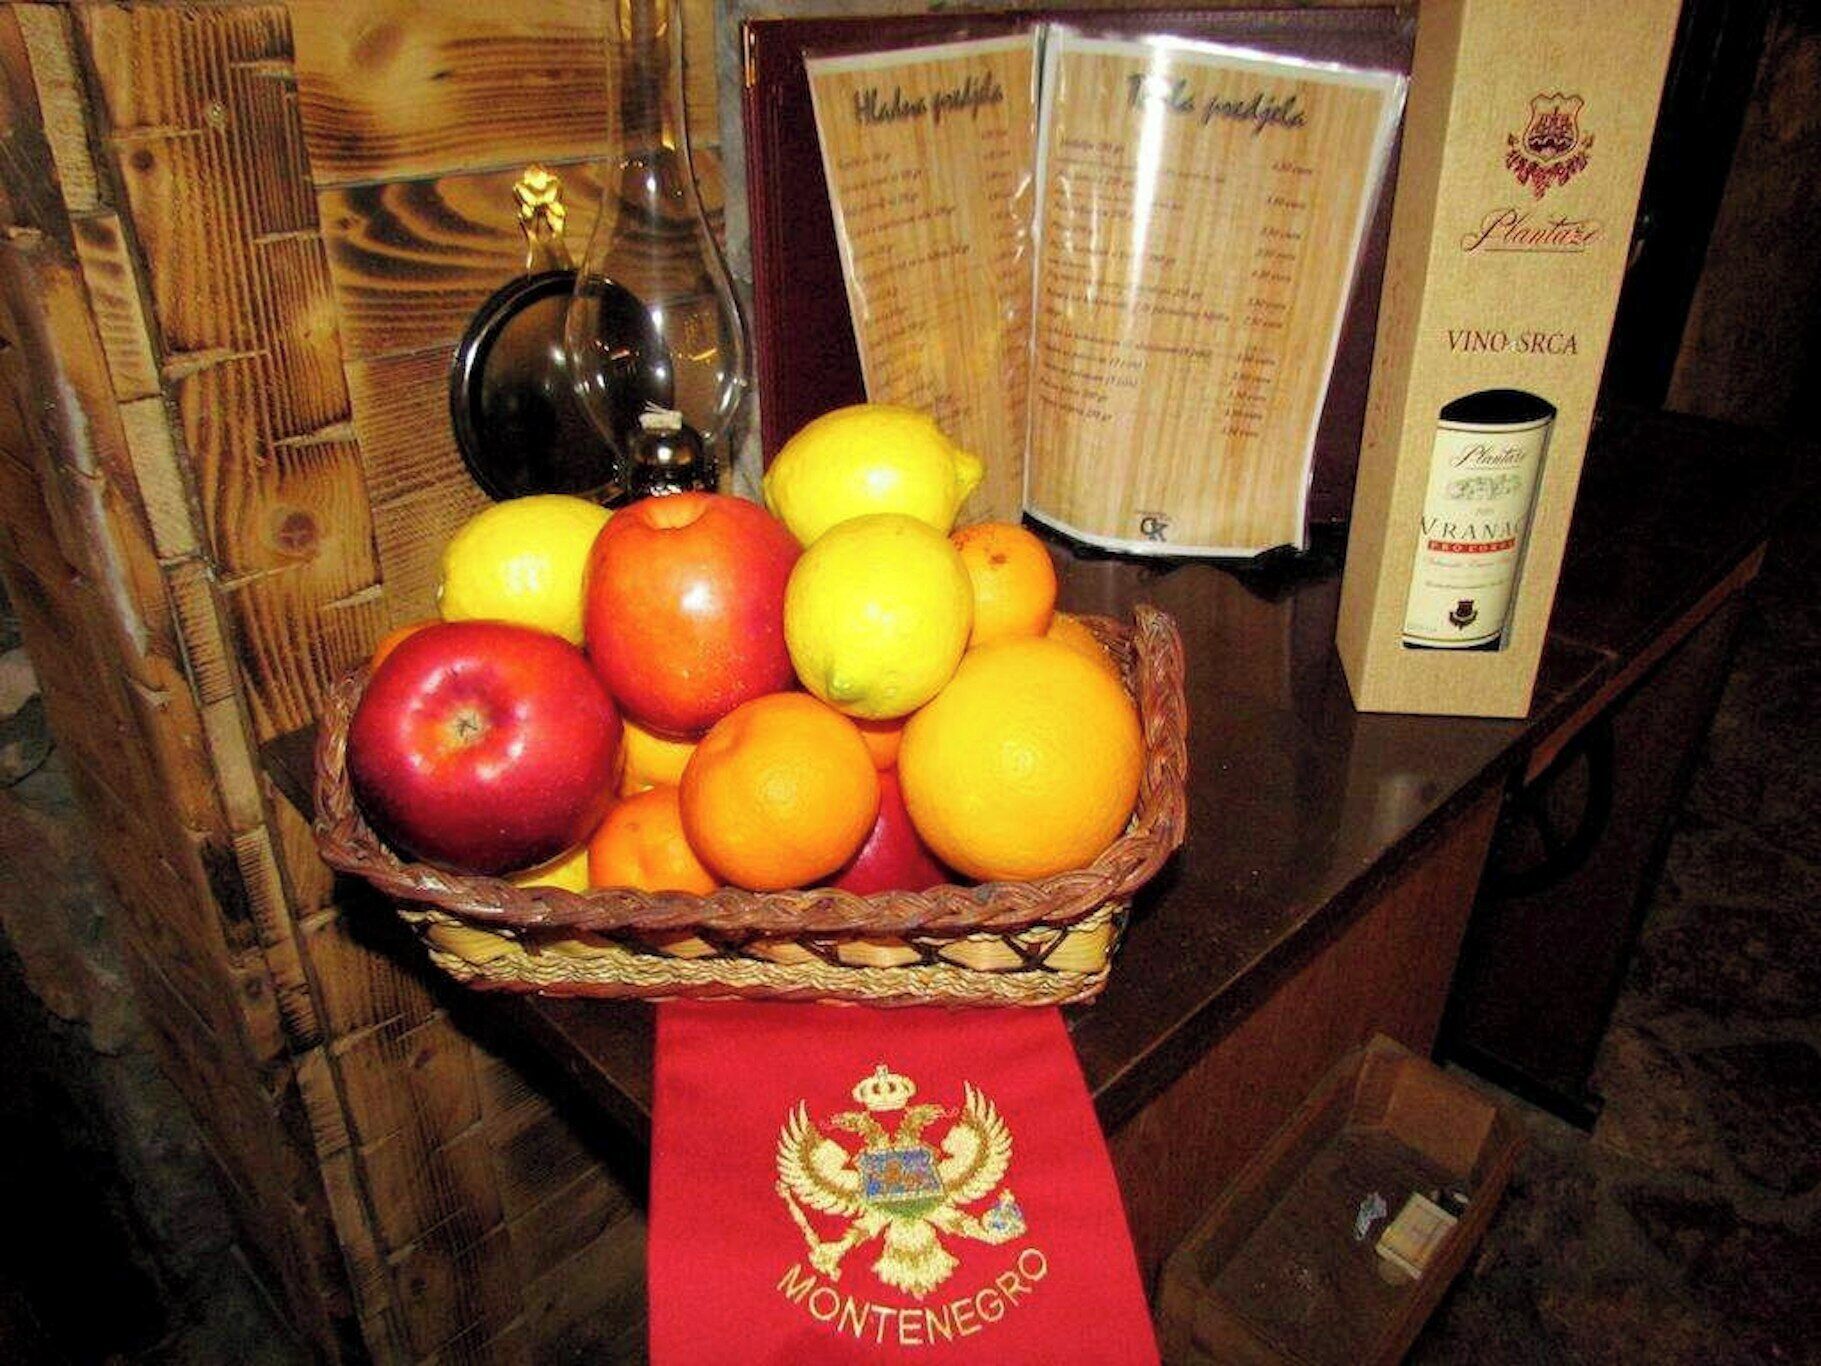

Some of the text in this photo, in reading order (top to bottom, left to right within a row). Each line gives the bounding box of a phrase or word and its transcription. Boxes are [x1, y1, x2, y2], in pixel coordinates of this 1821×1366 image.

[1448, 329, 1577, 354] VINO SRCA
[776, 1248, 1048, 1345] MONTENEGRO
